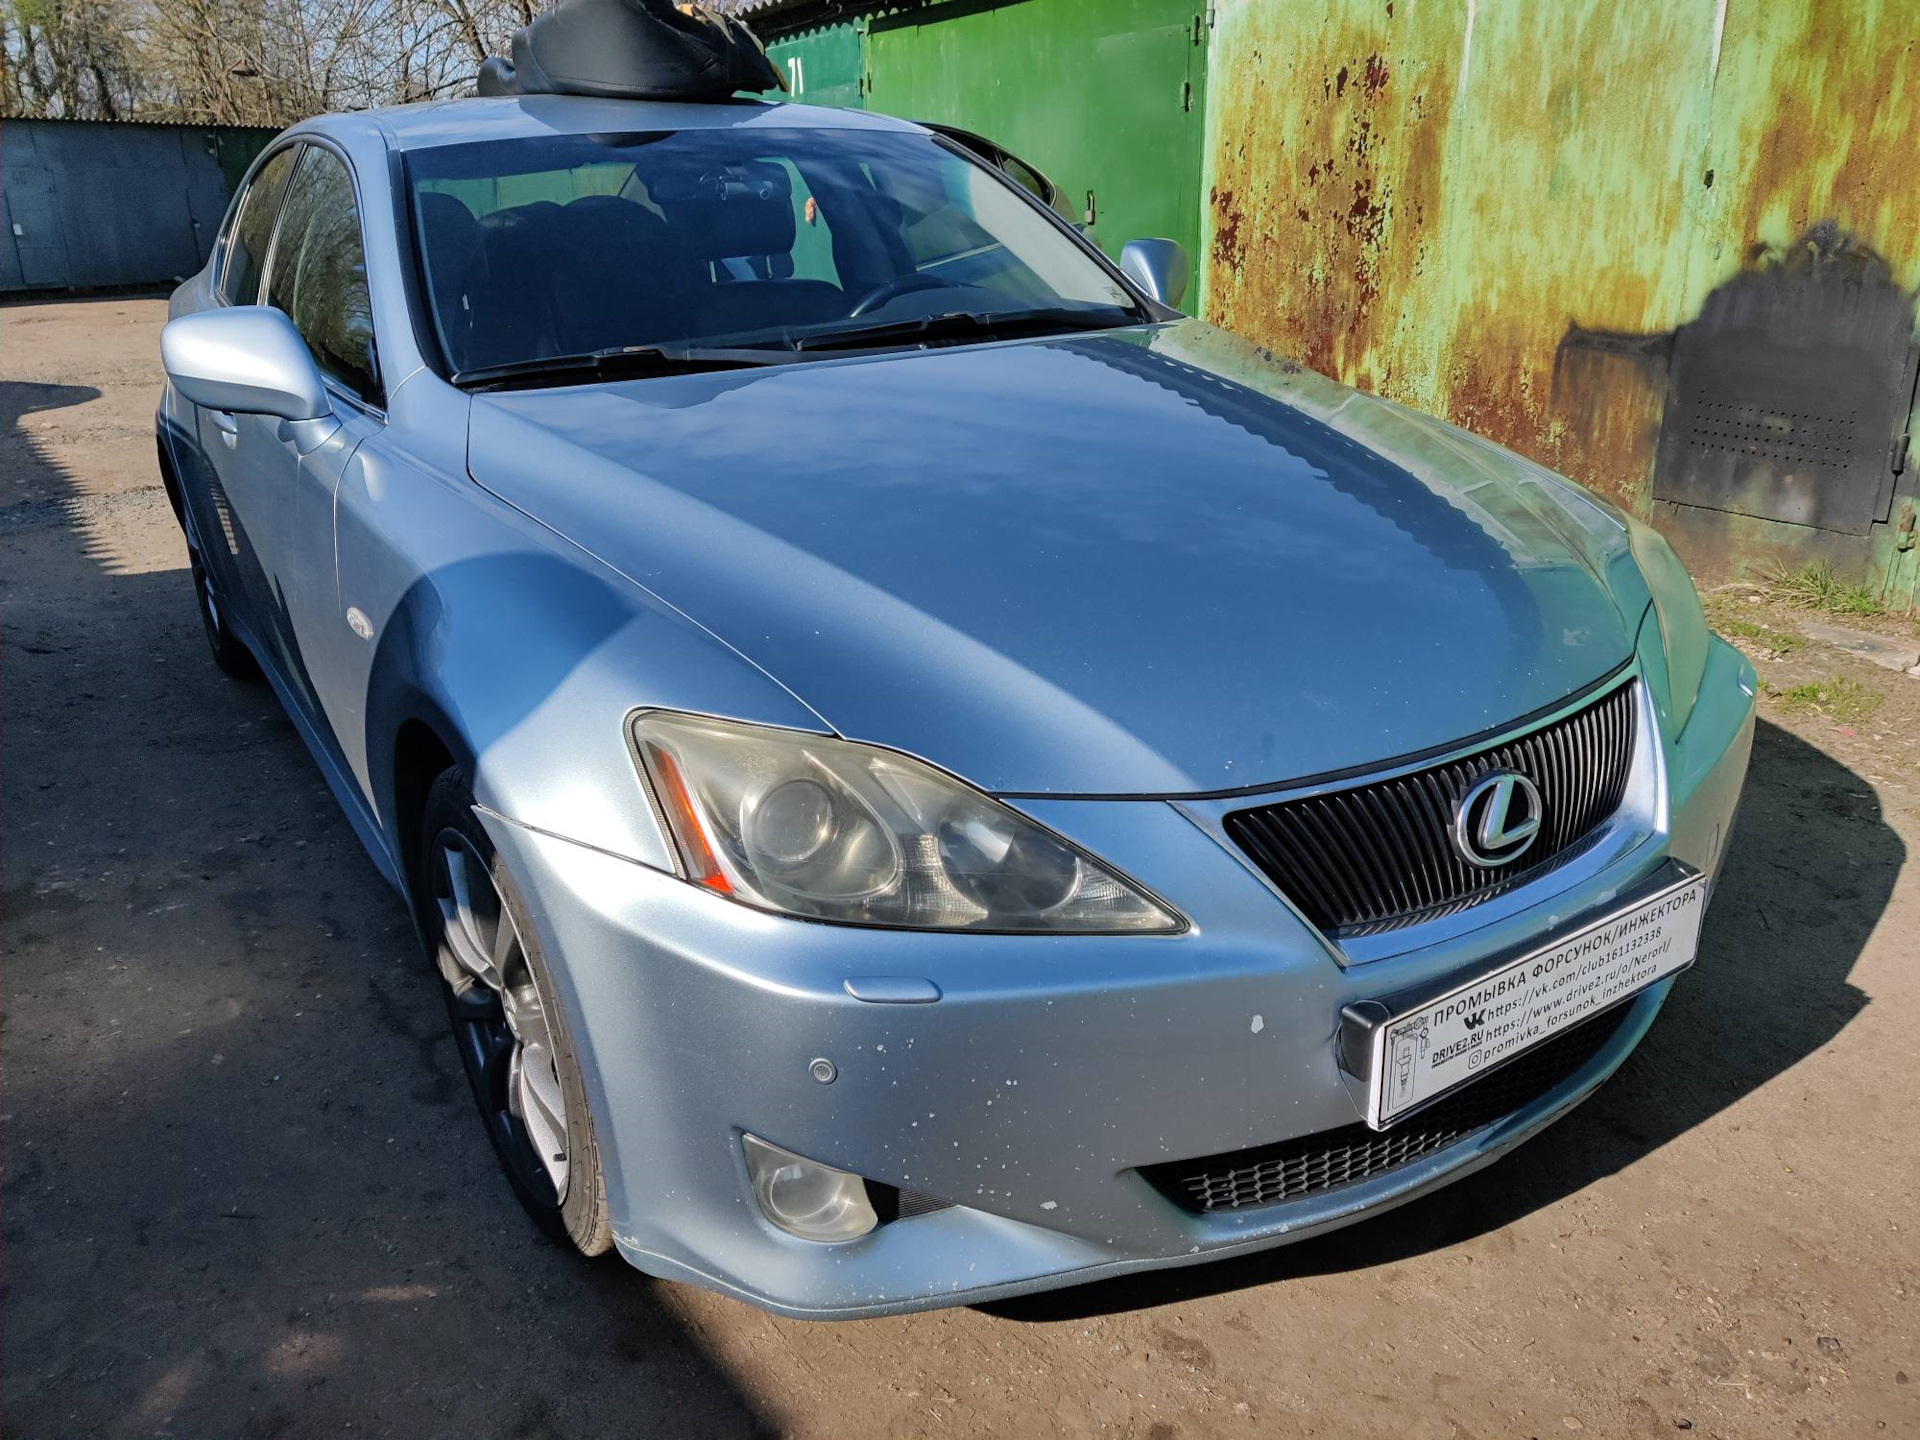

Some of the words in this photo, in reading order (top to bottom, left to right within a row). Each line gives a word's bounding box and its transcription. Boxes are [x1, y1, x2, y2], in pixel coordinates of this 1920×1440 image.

[787, 57, 804, 97] 71
[1433, 971, 1526, 1027] ПРОМЫВКА
[1532, 889, 1696, 978] ФОРСУНОК/ИНЖЕКТОРА
[1487, 926, 1662, 1022] https://vk.com/club161132338
[1431, 1029, 1485, 1064] DRIVE2.RU
[1483, 963, 1657, 1064] promivka_forsunok_inzhektora
